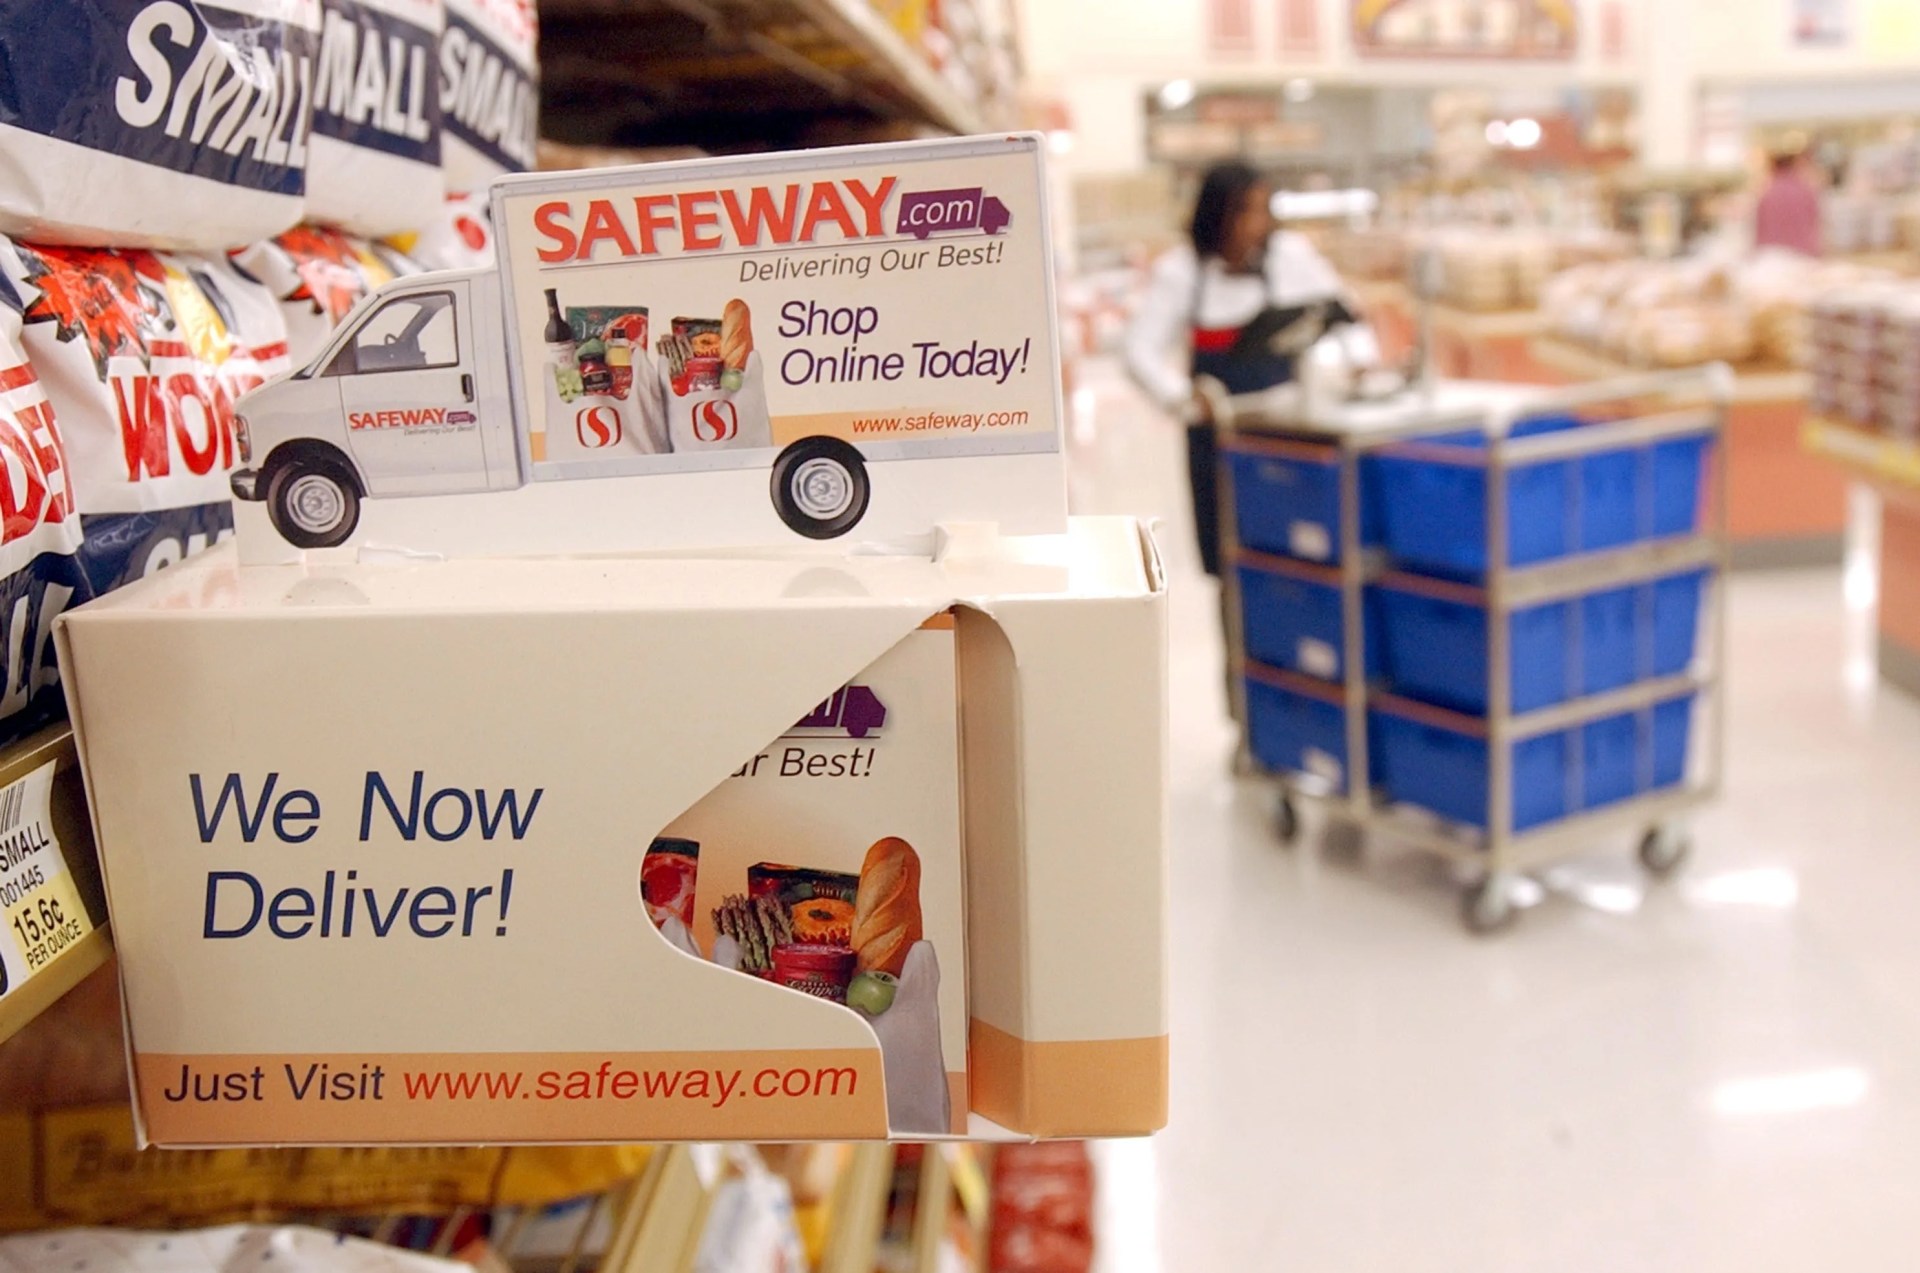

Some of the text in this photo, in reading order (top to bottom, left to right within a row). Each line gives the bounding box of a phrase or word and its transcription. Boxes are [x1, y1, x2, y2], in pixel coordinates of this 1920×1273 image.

[116, 1, 306, 167] SMALL
[315, 11, 431, 144] MALL
[534, 176, 974, 263] SAFEWAY .com
[739, 242, 1004, 283] Delivering Our Best!
[778, 301, 879, 342] Shop
[781, 338, 1031, 385] Online Today!
[349, 408, 446, 429] SAFEWAY
[852, 409, 1029, 434] www.safeway.com
[779, 747, 875, 777] Best!
[189, 770, 544, 843] We Now
[0, 821, 50, 872] SMALL
[203, 868, 515, 939] Deliver!
[26, 918, 83, 970] PER OUNCE
[164, 1061, 858, 1108] Just Visit www.safeway.com
